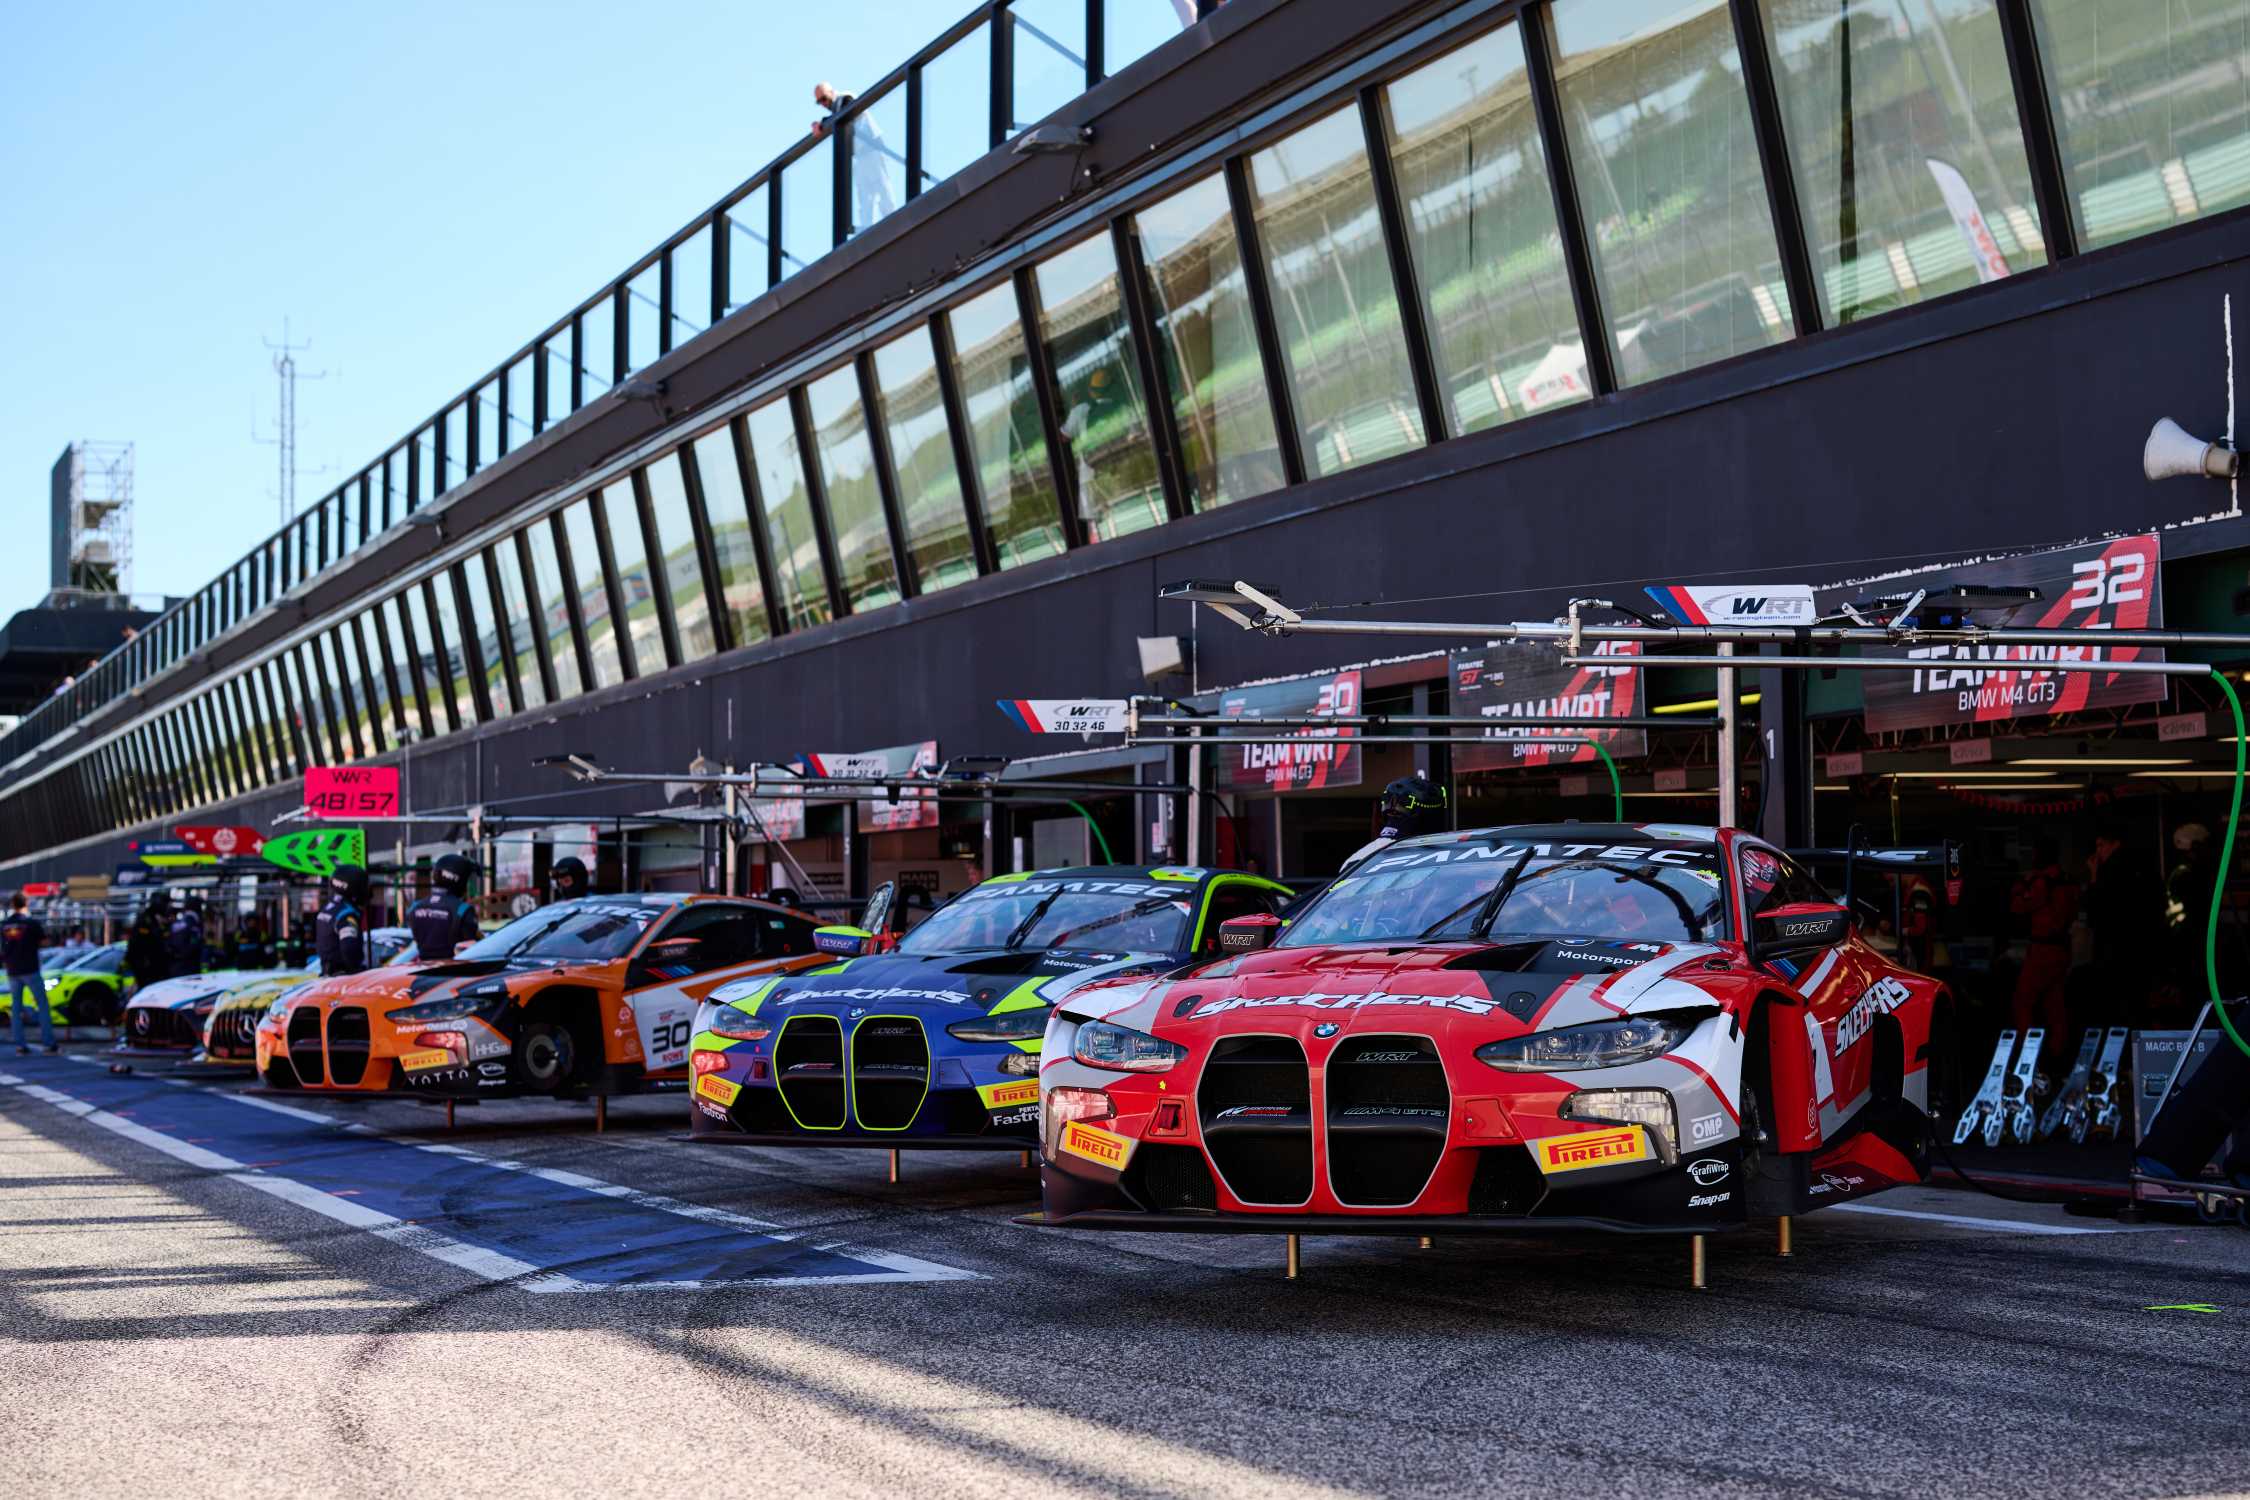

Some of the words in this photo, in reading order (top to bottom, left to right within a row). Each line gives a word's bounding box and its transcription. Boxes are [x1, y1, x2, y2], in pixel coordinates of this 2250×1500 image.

[2071, 553, 2145, 609] 32
[1733, 597, 1808, 614] WRT
[1908, 645, 2011, 693] TEAM
[1318, 681, 1354, 716] 30
[1958, 690, 1998, 711] BMW
[2001, 686, 2024, 706] M4
[2027, 682, 2056, 703] GT3
[1070, 706, 1115, 717] WRT
[1481, 699, 1547, 737] TEAM
[1551, 691, 1611, 733] WRT
[1054, 721, 1070, 731] 30
[1072, 721, 1087, 731] 32
[1090, 721, 1105, 731] 46
[1241, 734, 1291, 769] TEAM
[1294, 727, 1338, 764] WRT
[1513, 744, 1539, 757] BMW
[1766, 729, 1775, 760] 1
[1265, 767, 1284, 783] BMW
[1365, 843, 1704, 874] FANATEC
[957, 882, 1184, 903] FANATEC
[1785, 919, 1833, 936] WRT
[1223, 933, 1255, 945] WRT
[777, 987, 972, 1005] SKECHERS
[1188, 991, 1500, 1020] SKECHERS
[653, 1019, 692, 1054] 30
[2145, 1041, 2176, 1053] MAGIC
[2198, 1042, 2206, 1052] B
[1356, 1051, 1418, 1063] WRT
[703, 1079, 733, 1100] PIRELLI
[698, 1101, 729, 1122] Fastron
[1692, 1114, 1723, 1140] OMP
[1070, 1127, 1122, 1162] PIRELLI
[1548, 1132, 1635, 1166] PIRELLI
[1691, 1162, 1729, 1177] GrafiWrap
[1687, 1191, 1731, 1208] Snap-on
